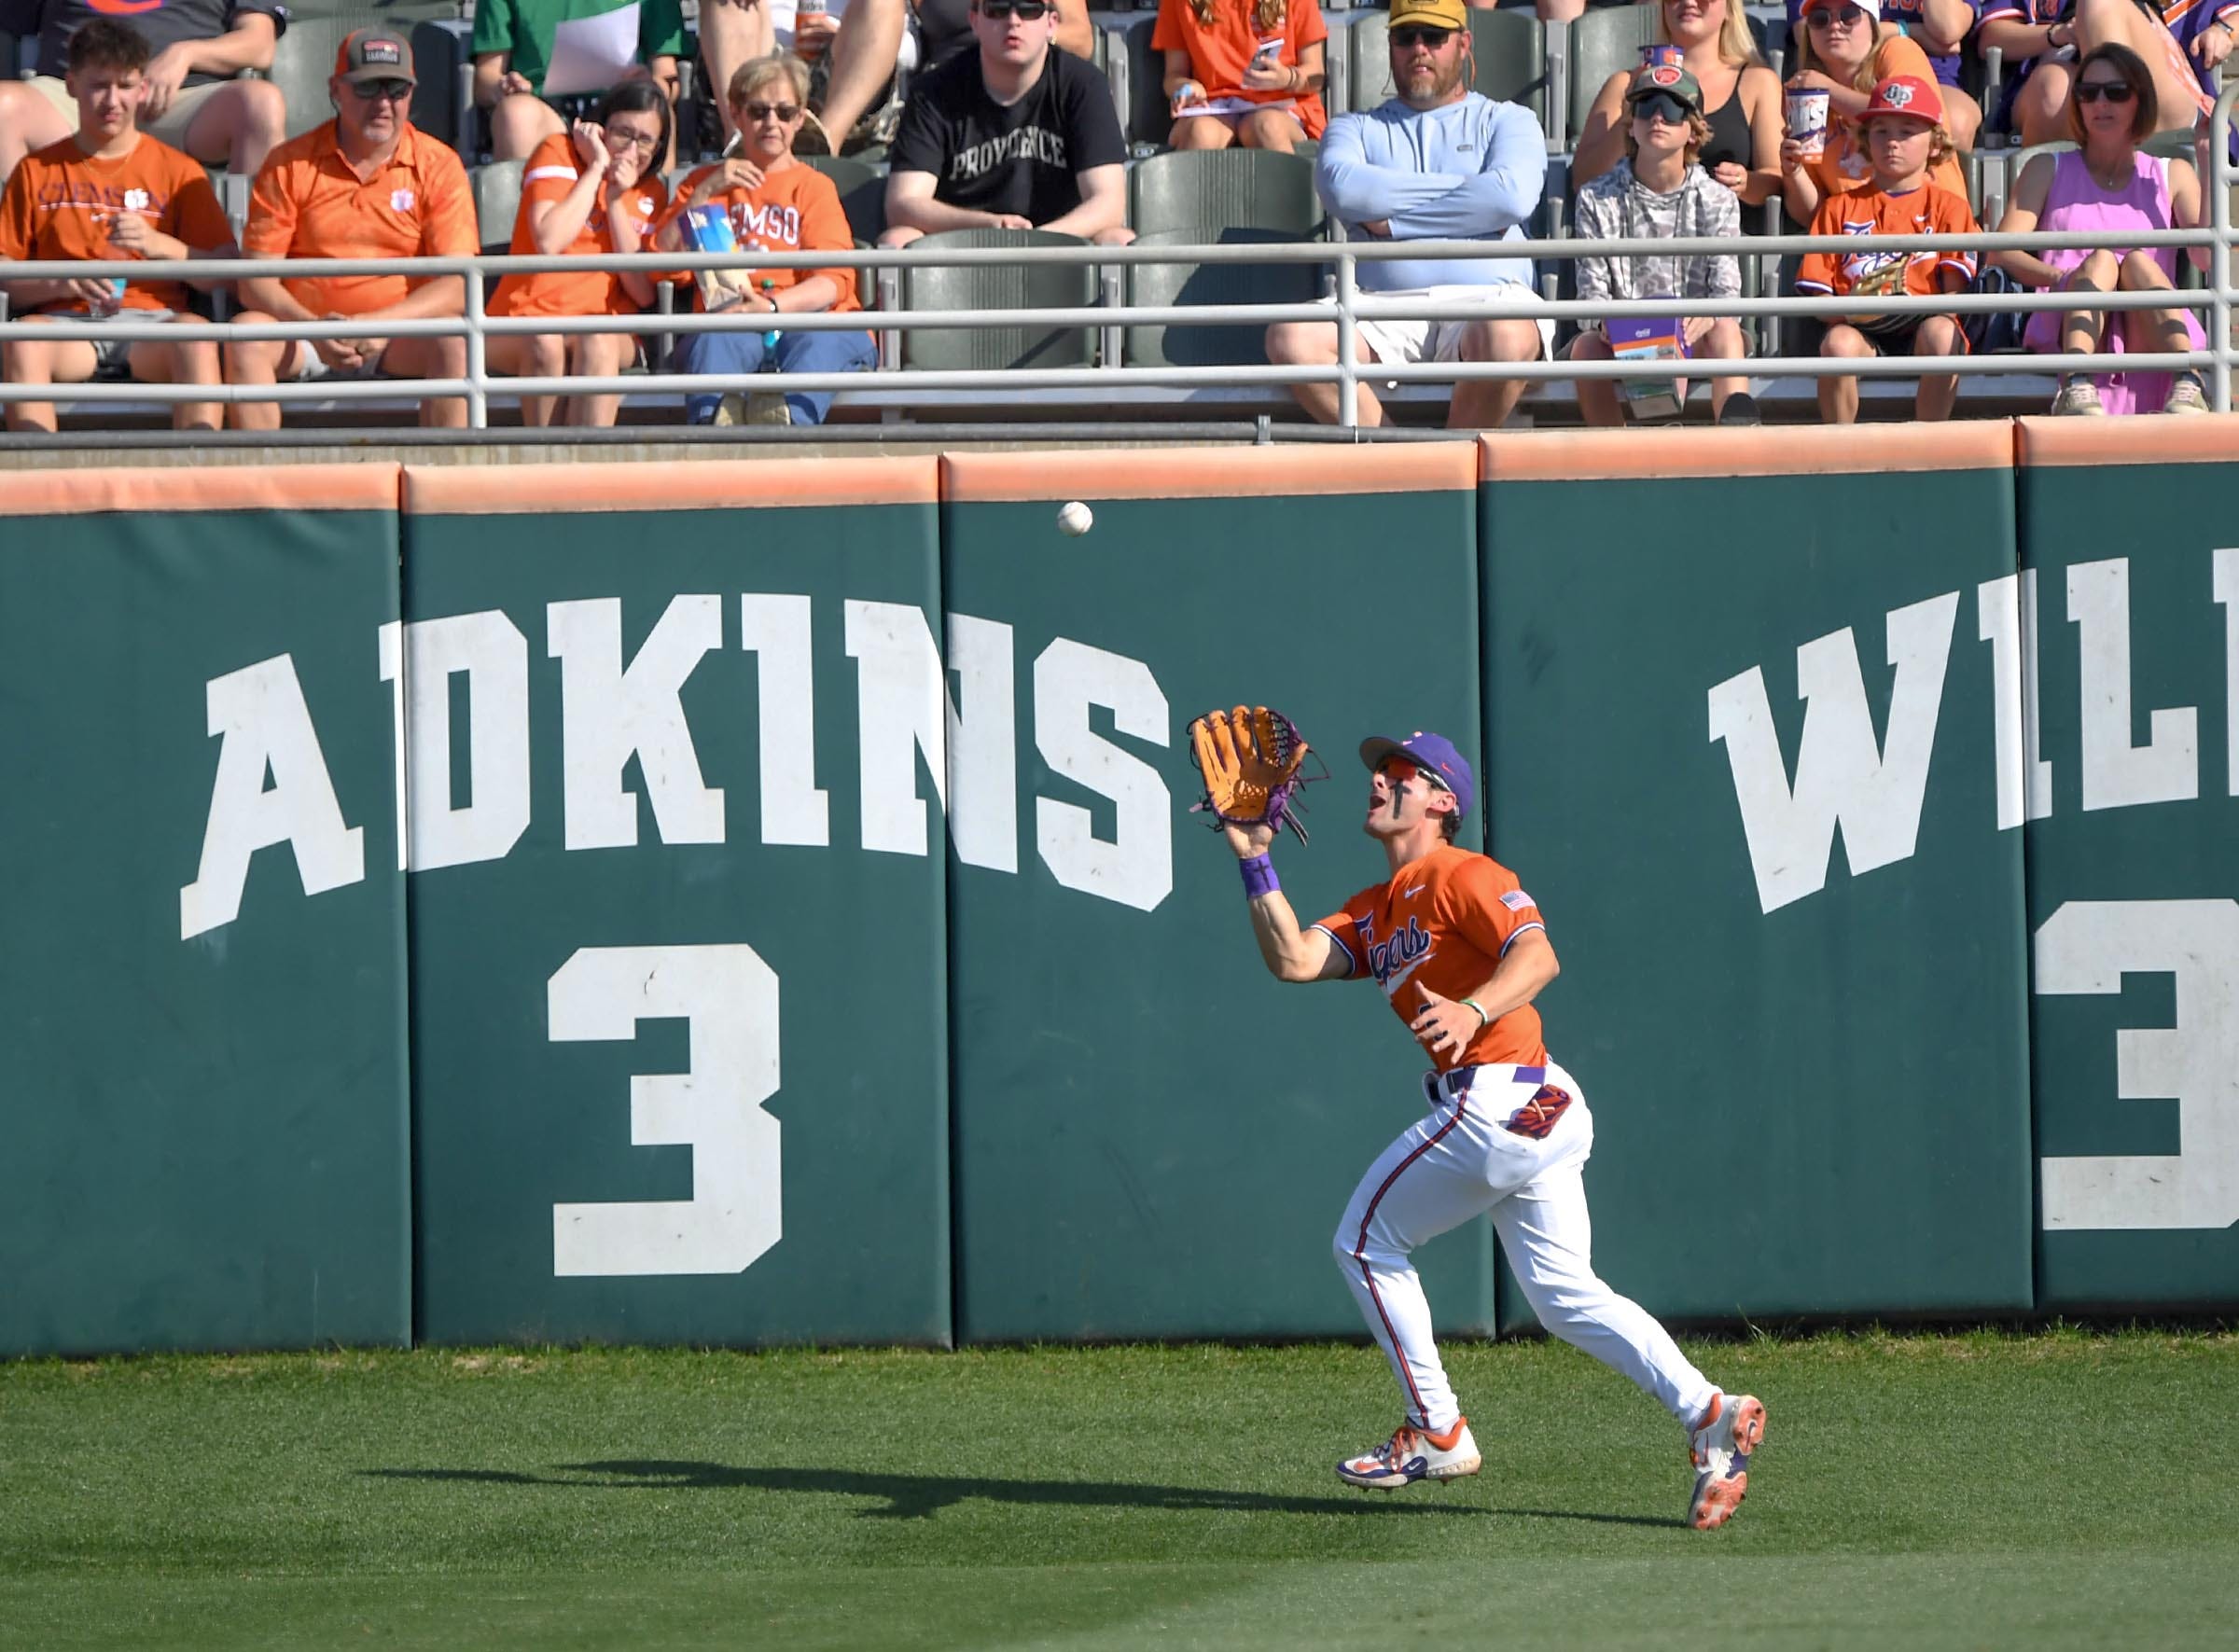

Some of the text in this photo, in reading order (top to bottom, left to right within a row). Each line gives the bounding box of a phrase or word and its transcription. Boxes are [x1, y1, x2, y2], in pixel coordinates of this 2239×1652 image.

[180, 592, 1174, 941] ADKINS
[1708, 548, 2239, 914] WIL
[548, 943, 782, 1276] 3
[2035, 898, 2239, 1230] 3
